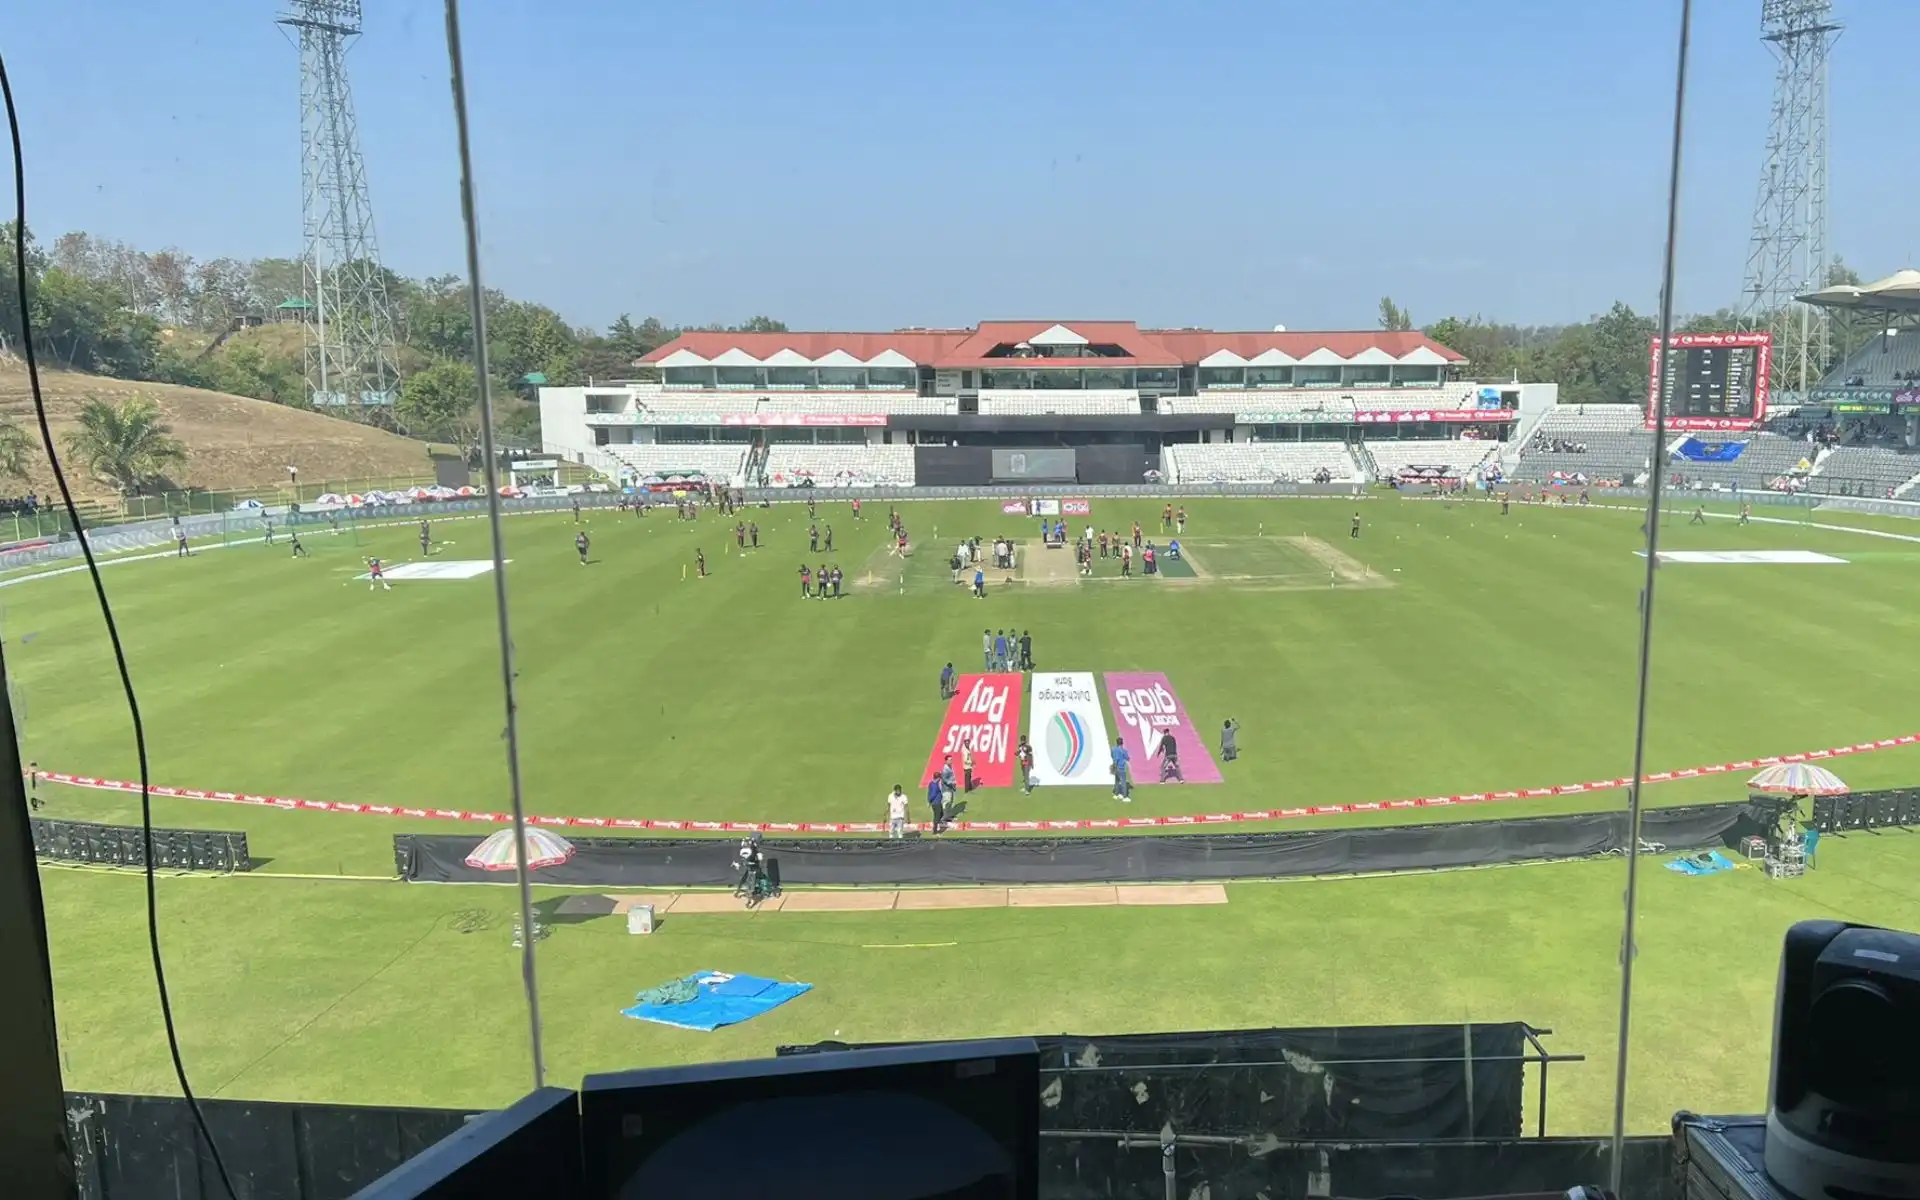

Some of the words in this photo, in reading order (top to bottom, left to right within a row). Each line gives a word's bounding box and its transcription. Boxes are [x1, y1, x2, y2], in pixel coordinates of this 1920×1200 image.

[962, 677, 1009, 723] Pay
[1054, 676, 1073, 688] Bank
[943, 723, 1009, 763] Nexus
